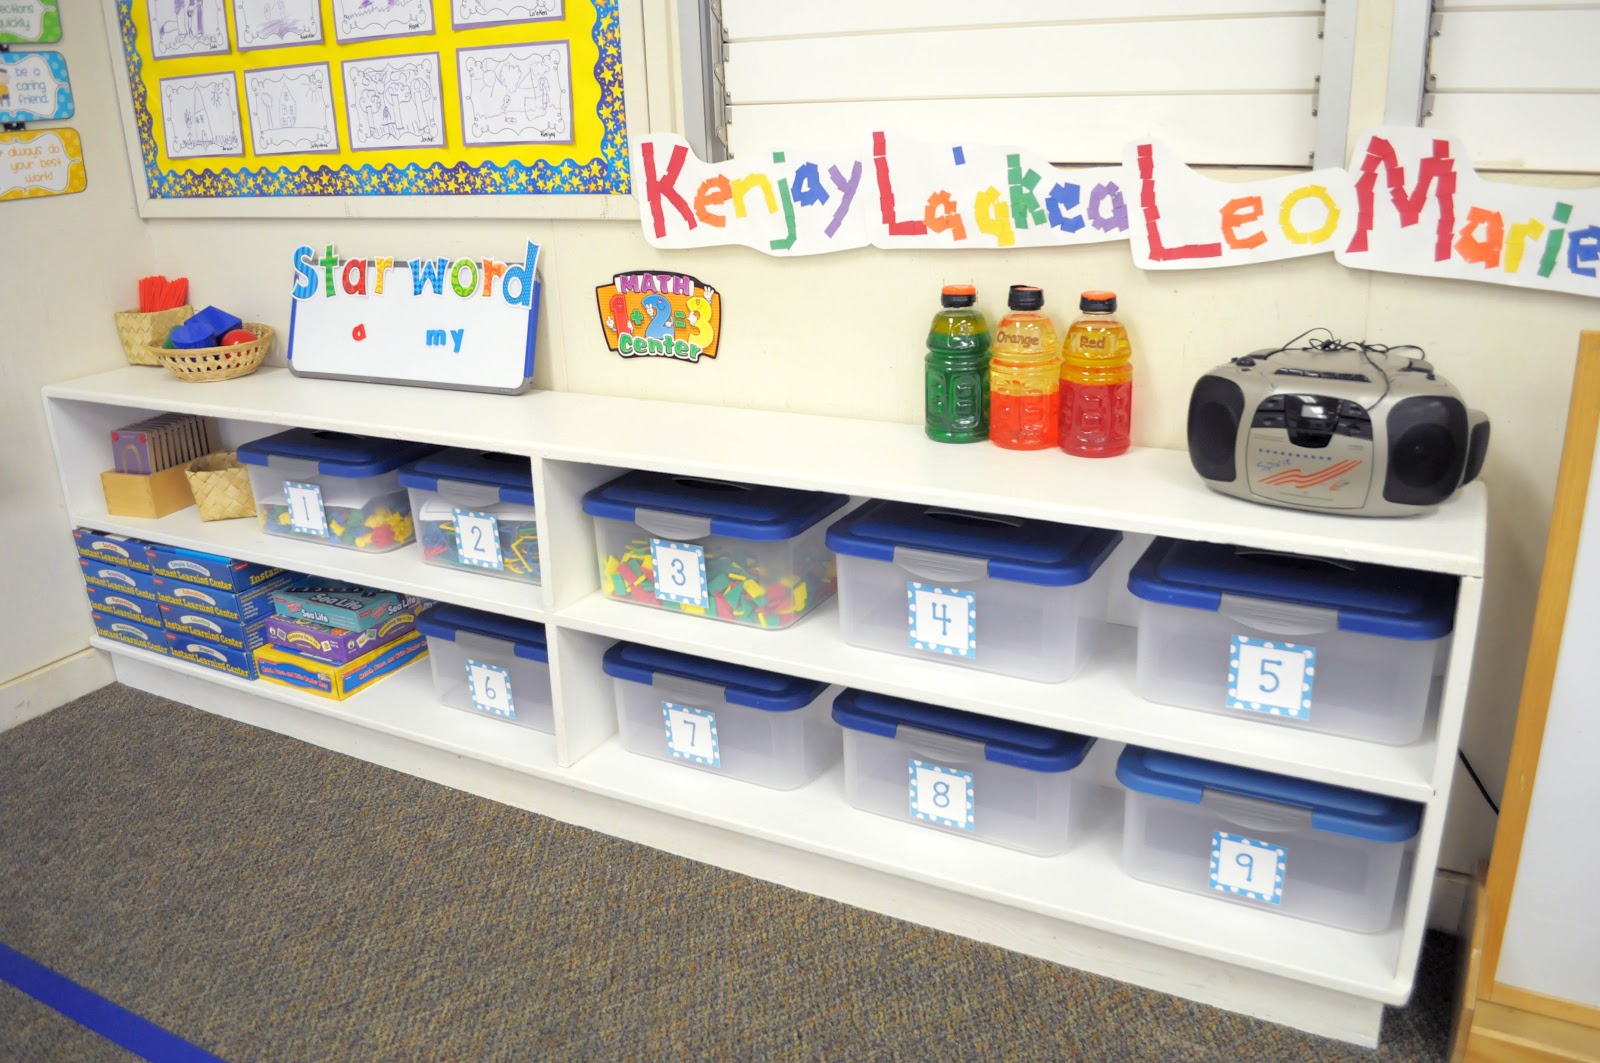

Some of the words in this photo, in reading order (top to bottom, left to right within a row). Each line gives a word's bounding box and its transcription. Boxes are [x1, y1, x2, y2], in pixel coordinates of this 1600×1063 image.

[15, 68, 28, 77] be
[33, 68, 41, 77] a
[16, 81, 46, 93] caring
[8, 146, 42, 159] always
[48, 143, 60, 154] do
[11, 161, 32, 174] your
[40, 156, 62, 168] best
[25, 171, 53, 183] work!
[641, 142, 863, 251] Kenjay
[1137, 143, 1341, 262] Leo
[1345, 135, 1600, 279] Marie
[291, 241, 395, 301] Star
[407, 236, 541, 310] word
[619, 272, 691, 297] MATH
[351, 323, 367, 341] a
[425, 328, 465, 353] my
[618, 333, 702, 360] Center
[996, 331, 1040, 349] Orange
[1079, 335, 1106, 349] Red
[301, 495, 311, 521] 1
[470, 525, 486, 553] 2
[128, 559, 150, 571] Center
[152, 565, 177, 578] Instant
[177, 570, 209, 585] Learning
[209, 577, 233, 590] Center
[249, 566, 284, 586] Instan
[670, 557, 687, 587] 3
[135, 588, 156, 600] Center
[157, 592, 183, 605] Instant
[183, 599, 215, 614] Learning
[214, 606, 239, 620] Center
[310, 593, 336, 604] Sea
[337, 598, 364, 610] Life
[387, 603, 402, 615] Sea
[402, 596, 416, 609] Life
[141, 614, 161, 627] Center
[301, 608, 315, 619] Sea
[315, 611, 329, 623] Life
[931, 601, 952, 637] 4
[164, 618, 189, 632] Instant
[189, 625, 220, 642] Learning
[220, 634, 243, 648] Center
[147, 641, 168, 654] Center
[170, 646, 195, 660] Instant
[195, 653, 227, 671] Learning
[226, 663, 249, 677] Center
[484, 676, 497, 700] 6
[1257, 657, 1284, 694] 5
[683, 718, 697, 748] 7
[932, 780, 950, 809] 8
[1235, 852, 1254, 883] 9
